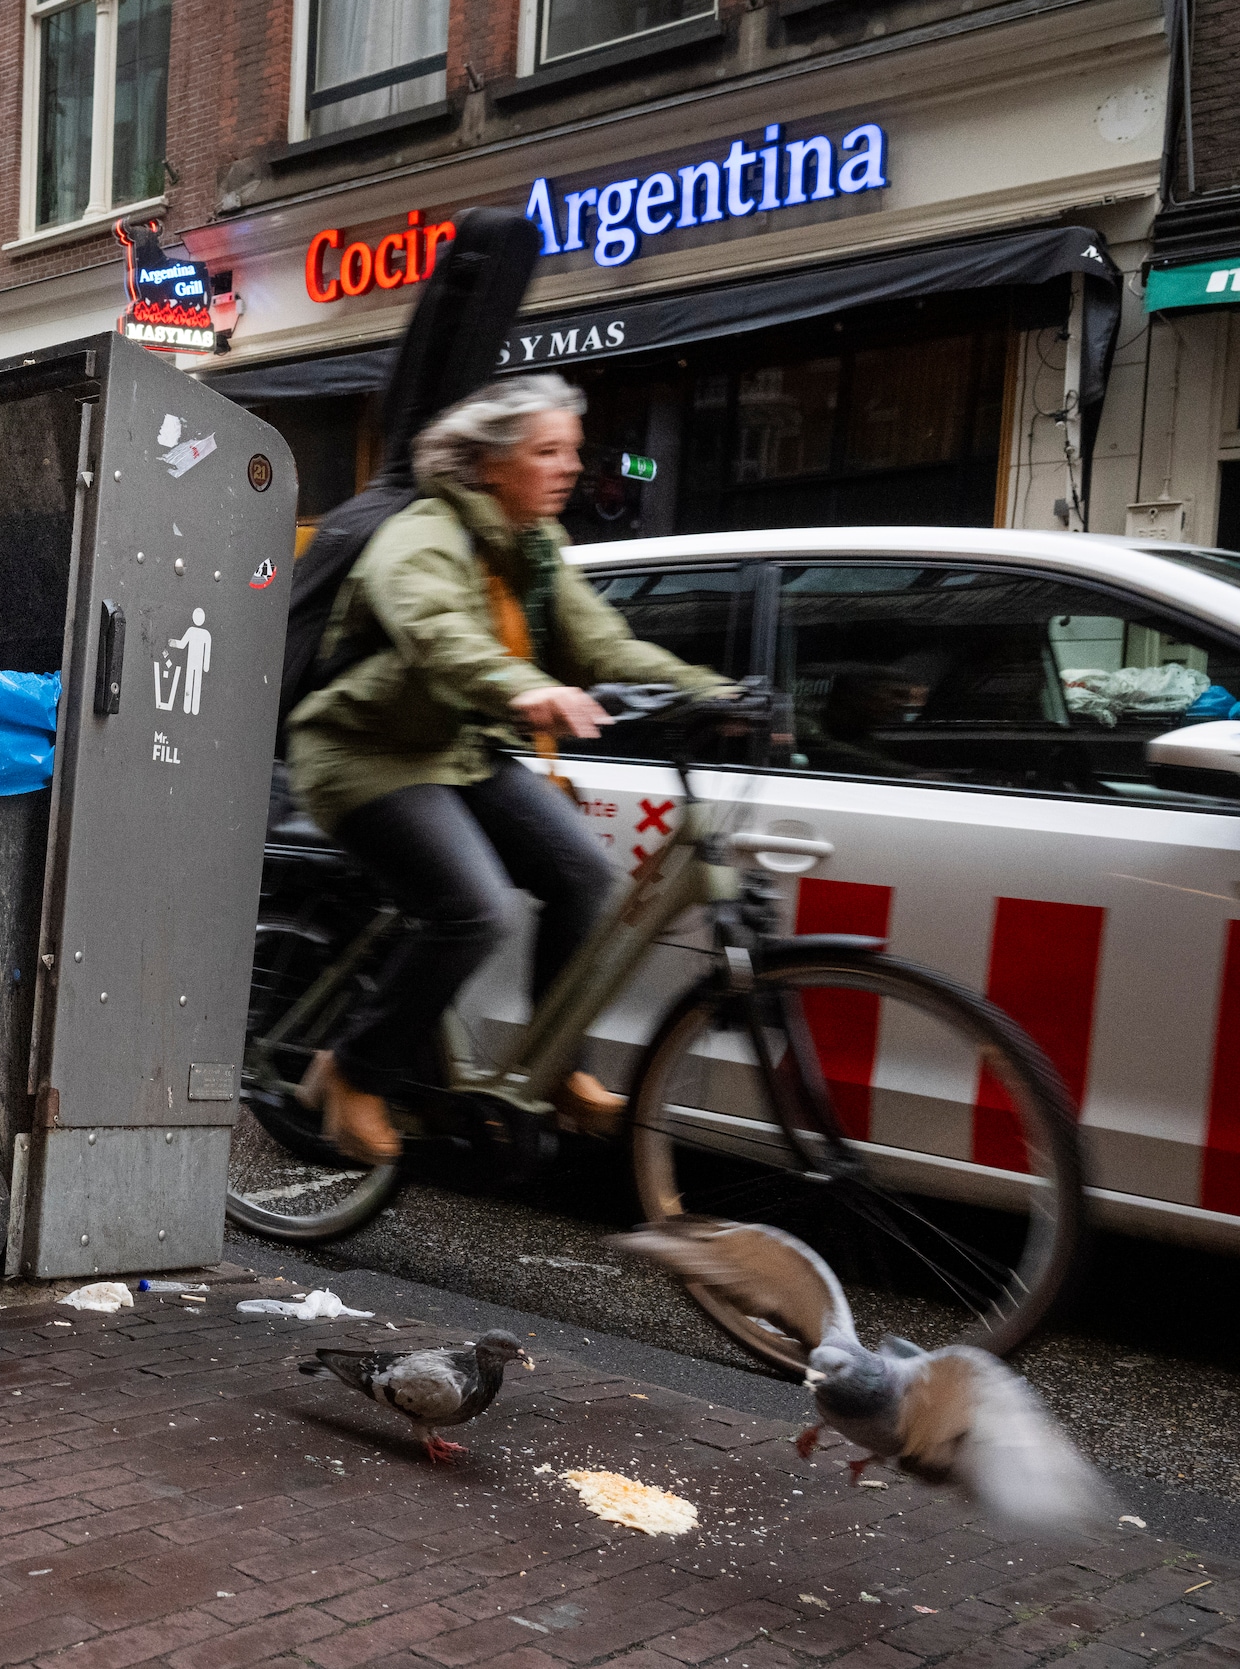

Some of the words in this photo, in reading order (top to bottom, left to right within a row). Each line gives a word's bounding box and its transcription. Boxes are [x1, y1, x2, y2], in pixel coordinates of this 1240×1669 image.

[526, 122, 888, 268] Argentina
[139, 263, 196, 285] Argentina
[175, 280, 204, 296] Grill
[126, 323, 214, 348] MASYMAS
[253, 464, 266, 480] 21
[154, 730, 169, 744] Mr.
[152, 744, 181, 764] FILL
